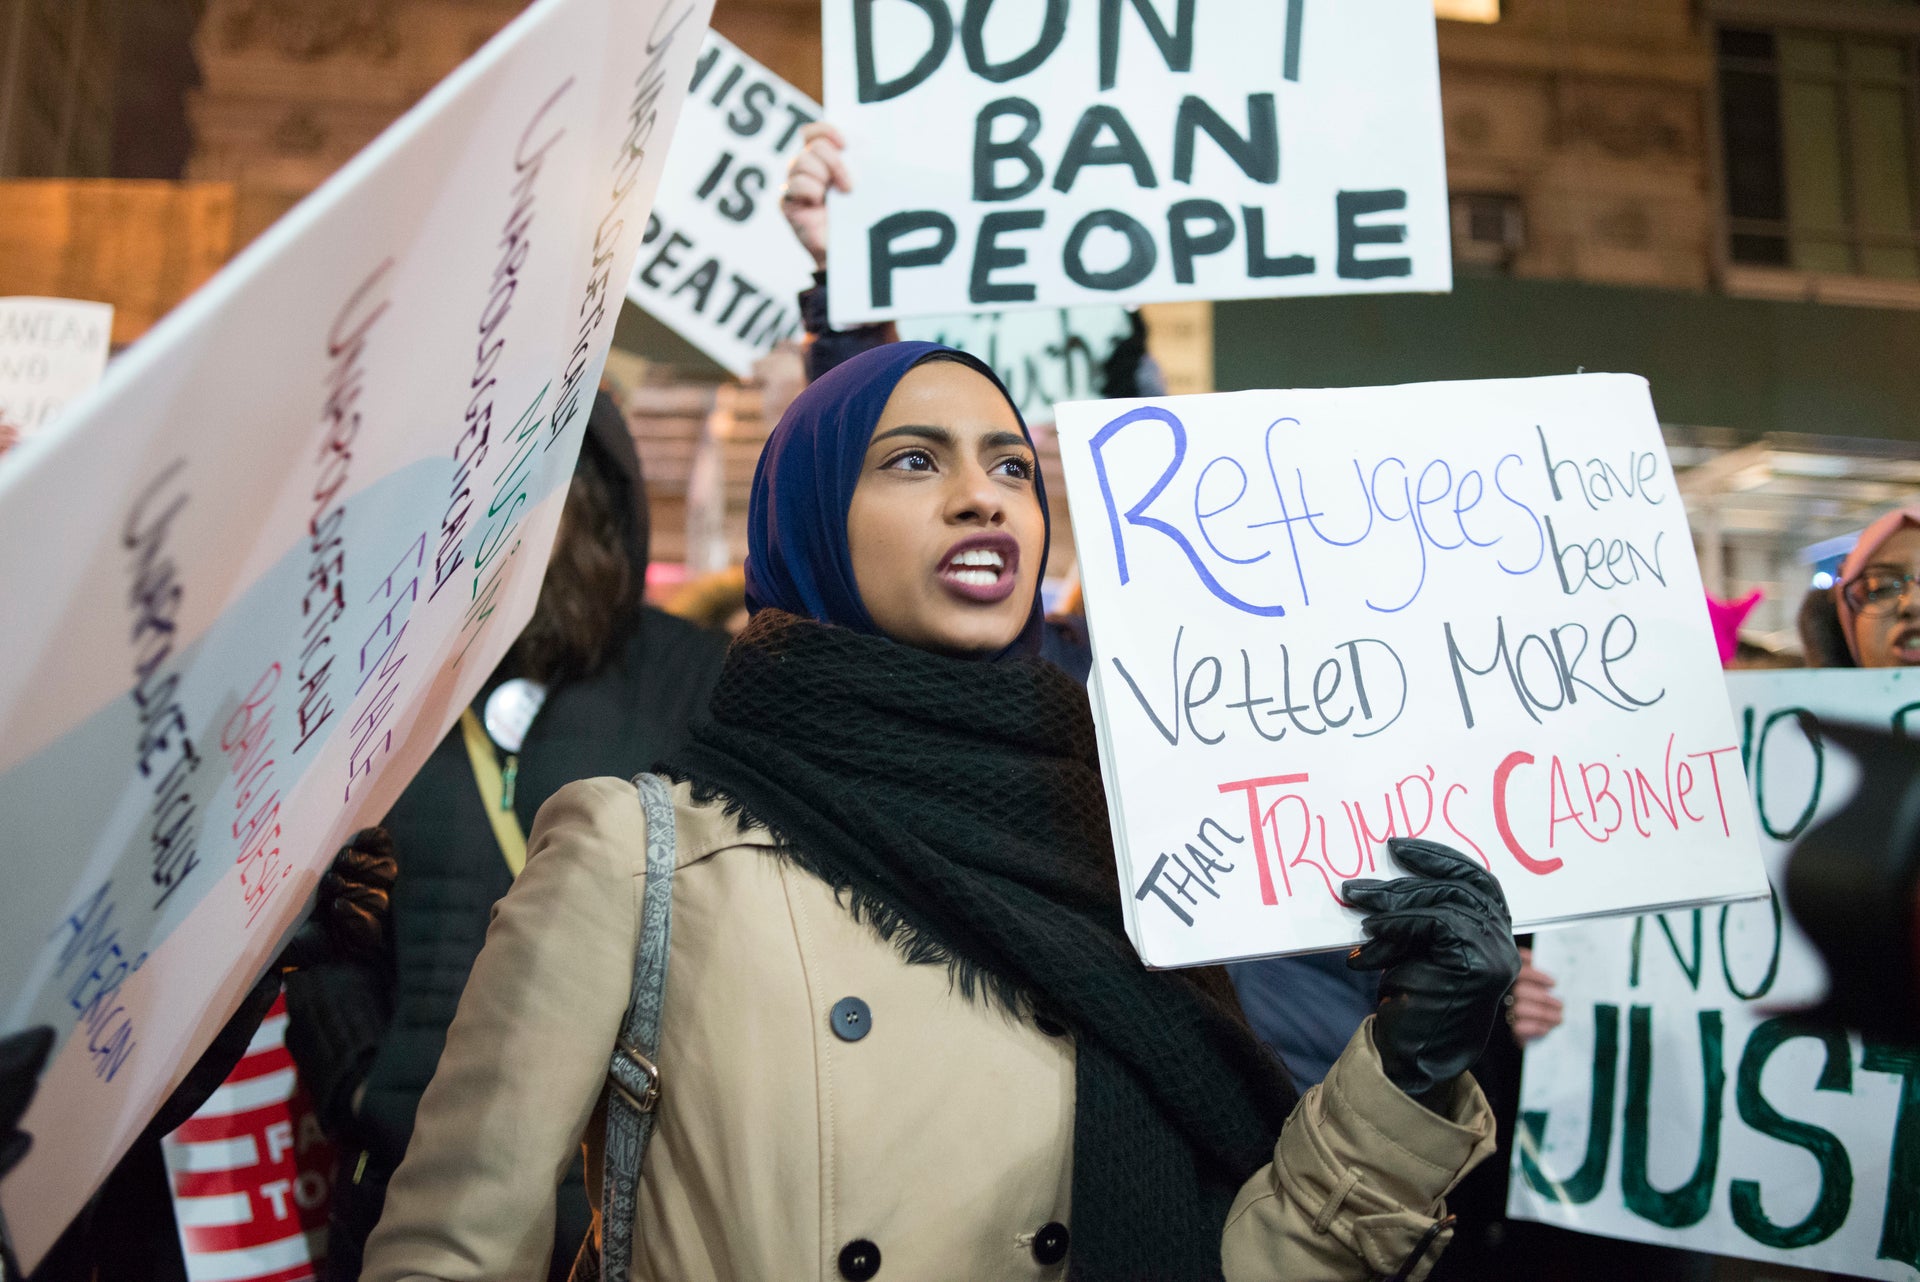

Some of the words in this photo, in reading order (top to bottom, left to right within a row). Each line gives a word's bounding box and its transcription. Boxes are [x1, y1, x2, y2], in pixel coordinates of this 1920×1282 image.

[697, 152, 767, 242] IS
[973, 93, 1279, 202] BAN
[868, 190, 1412, 308] PEOPLE
[1089, 406, 1543, 616] Refugees
[1536, 425, 1666, 511] have
[345, 531, 427, 804] FEMALE
